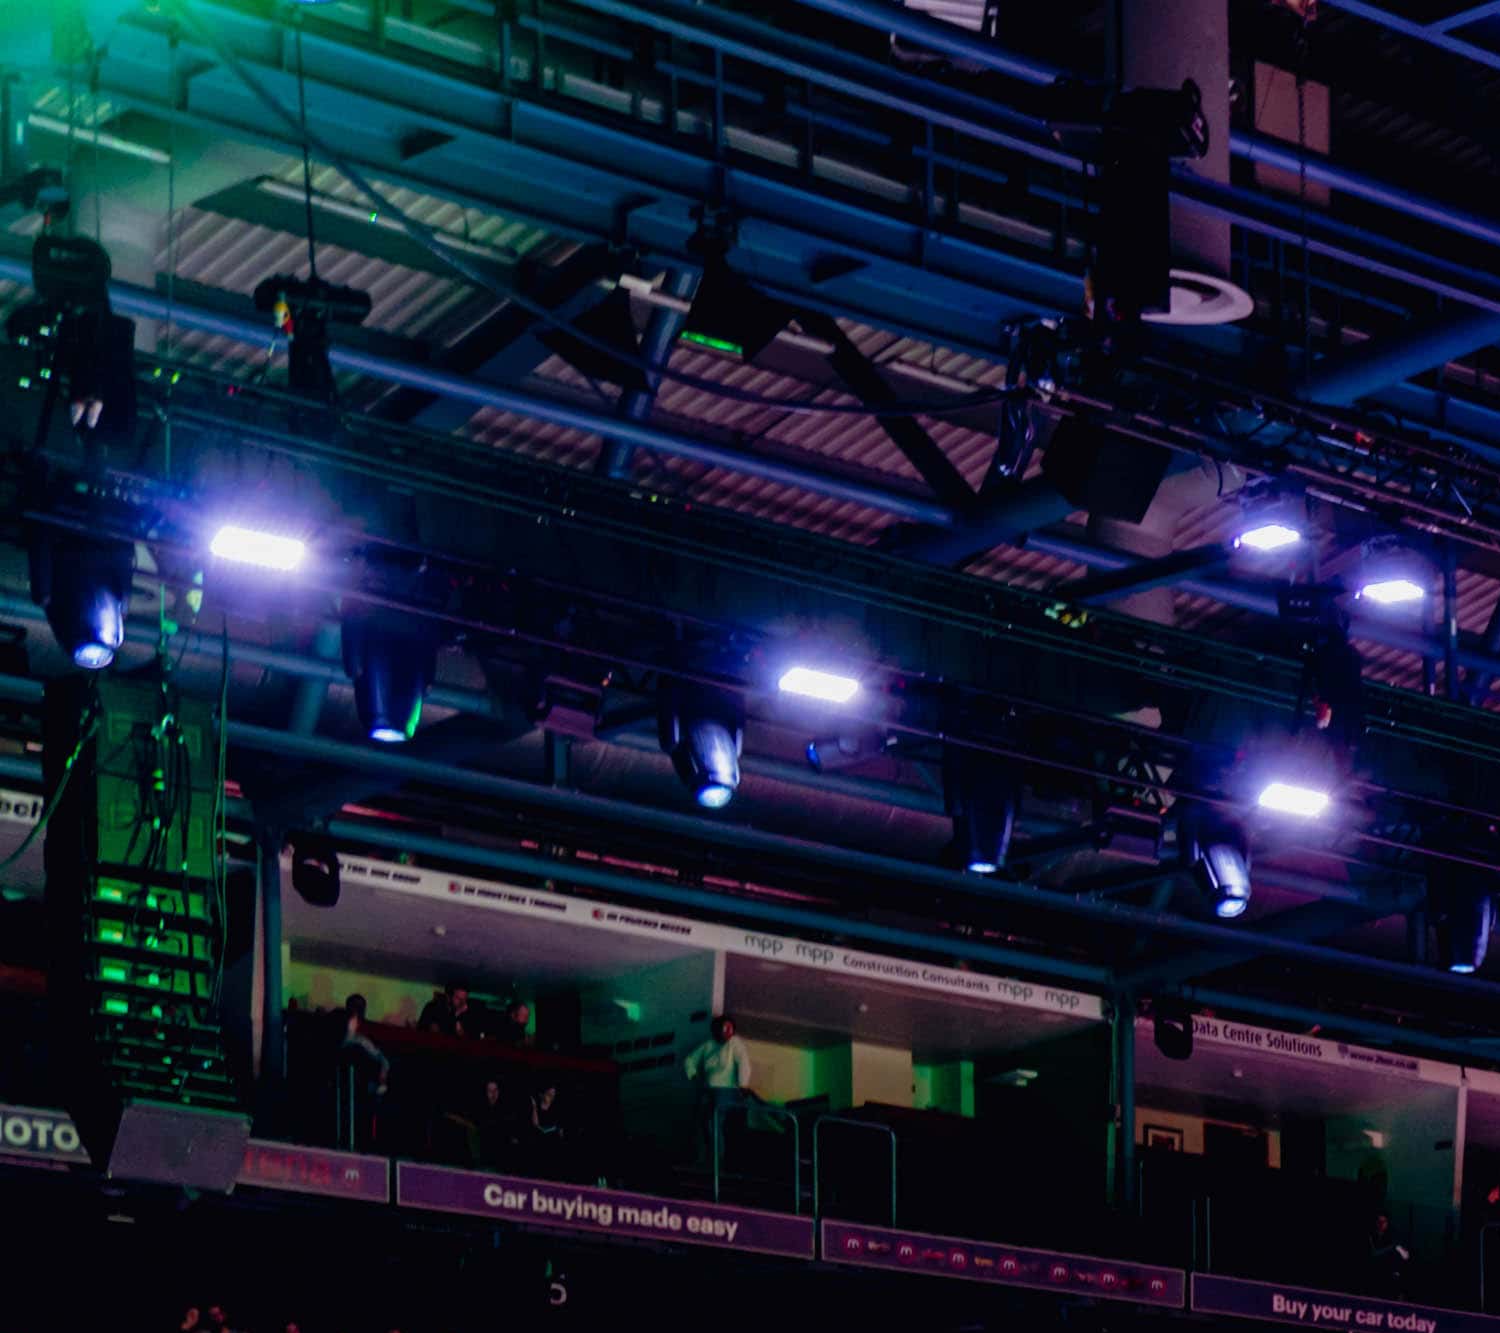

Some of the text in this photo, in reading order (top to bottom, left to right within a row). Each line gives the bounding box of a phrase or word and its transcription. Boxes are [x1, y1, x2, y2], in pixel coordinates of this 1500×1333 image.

[745, 933, 1081, 1008] mpp mpp Construction Consultants mpp mpp
[1191, 1018, 1322, 1057] Data Centre Solutions
[0, 1114, 81, 1152] OTO
[483, 1182, 738, 1242] Car buying made easy
[1272, 1293, 1308, 1321] Buy
[1311, 1301, 1353, 1325] your
[1356, 1306, 1382, 1326] car
